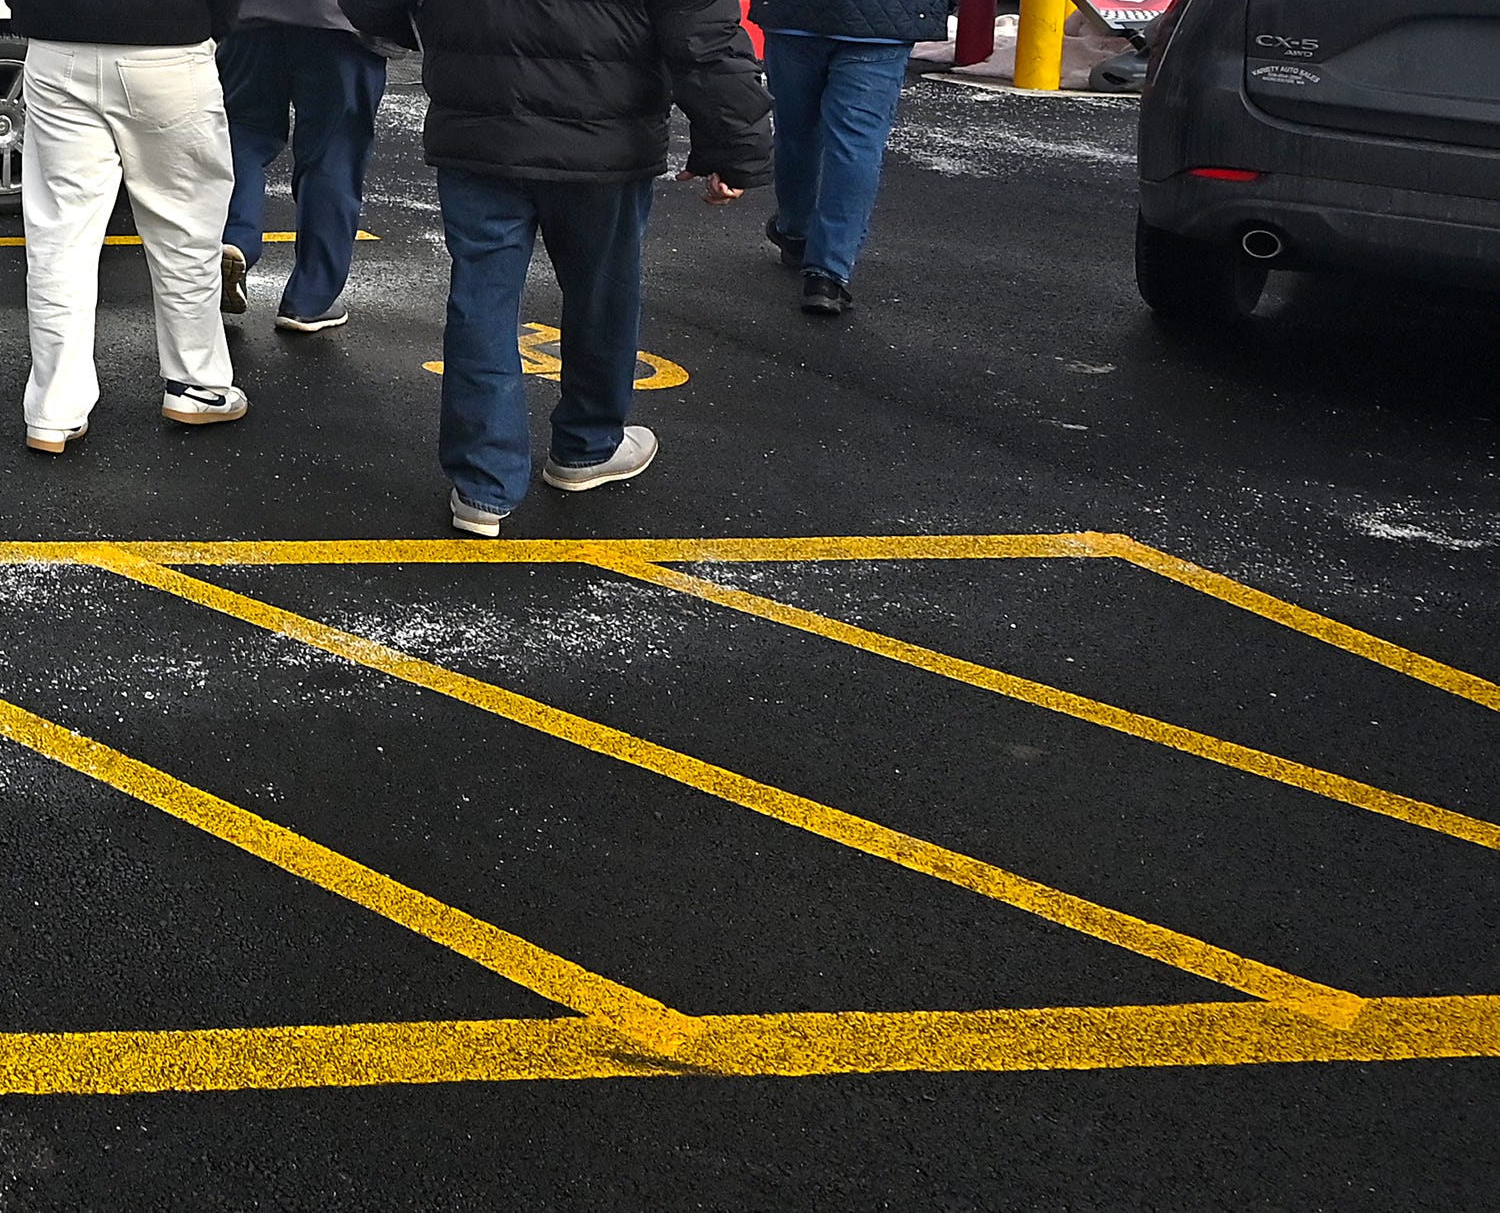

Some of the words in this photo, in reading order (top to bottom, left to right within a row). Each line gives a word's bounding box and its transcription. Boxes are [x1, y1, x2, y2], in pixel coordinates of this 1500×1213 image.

[1255, 34, 1319, 50] CX-5
[1284, 49, 1314, 58] AWD
[1280, 66, 1299, 74] AUTO
[1299, 69, 1320, 83] SALES
